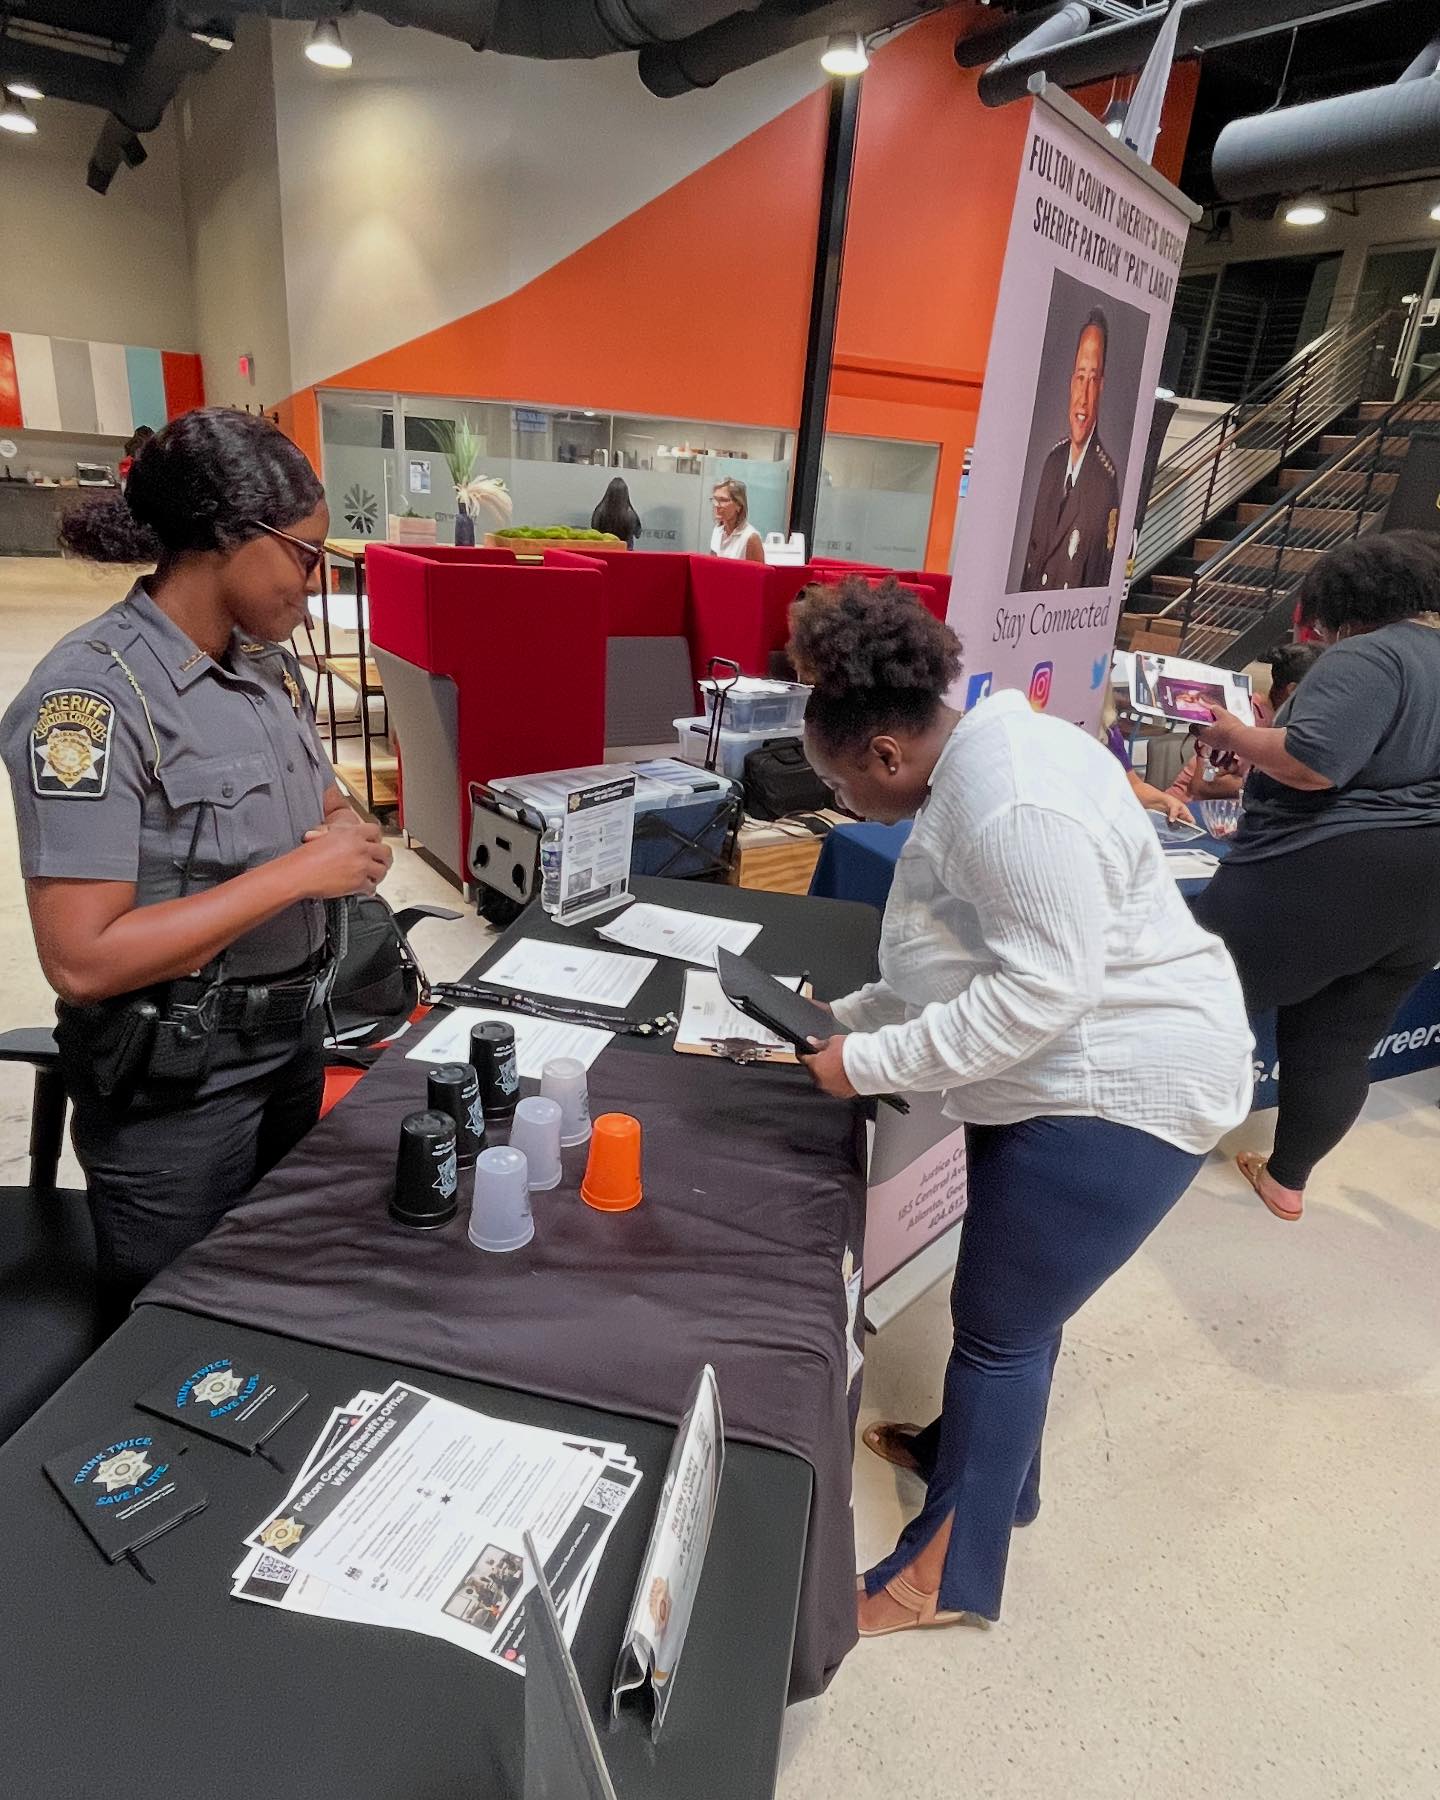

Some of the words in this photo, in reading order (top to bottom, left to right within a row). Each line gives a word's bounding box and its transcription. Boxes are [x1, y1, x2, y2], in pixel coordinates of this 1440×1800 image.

[1029, 134, 1076, 195] FULTON
[1076, 167, 1117, 223] COUNTY
[1116, 196, 1159, 250] SHERIFF'S
[1033, 196, 1080, 253] SHERIFF
[1078, 225, 1122, 277] PATRICK
[992, 607, 1025, 648] Stay
[1030, 596, 1111, 635] Connected
[38, 694, 111, 718] SHERIFF
[915, 1171, 950, 1206] Central
[920, 1158, 951, 1186] Justice
[176, 1379, 195, 1409] THINK
[209, 1399, 240, 1418] SAVE
[292, 1481, 326, 1512] Fulton
[319, 1449, 355, 1483] County
[380, 1390, 409, 1417] Office
[331, 1470, 352, 1487] WE
[346, 1450, 369, 1472] ARE
[362, 1418, 397, 1453] HIRING!
[74, 1452, 107, 1485] THINK
[95, 1490, 132, 1506] SAVE
[134, 1486, 144, 1496] A
